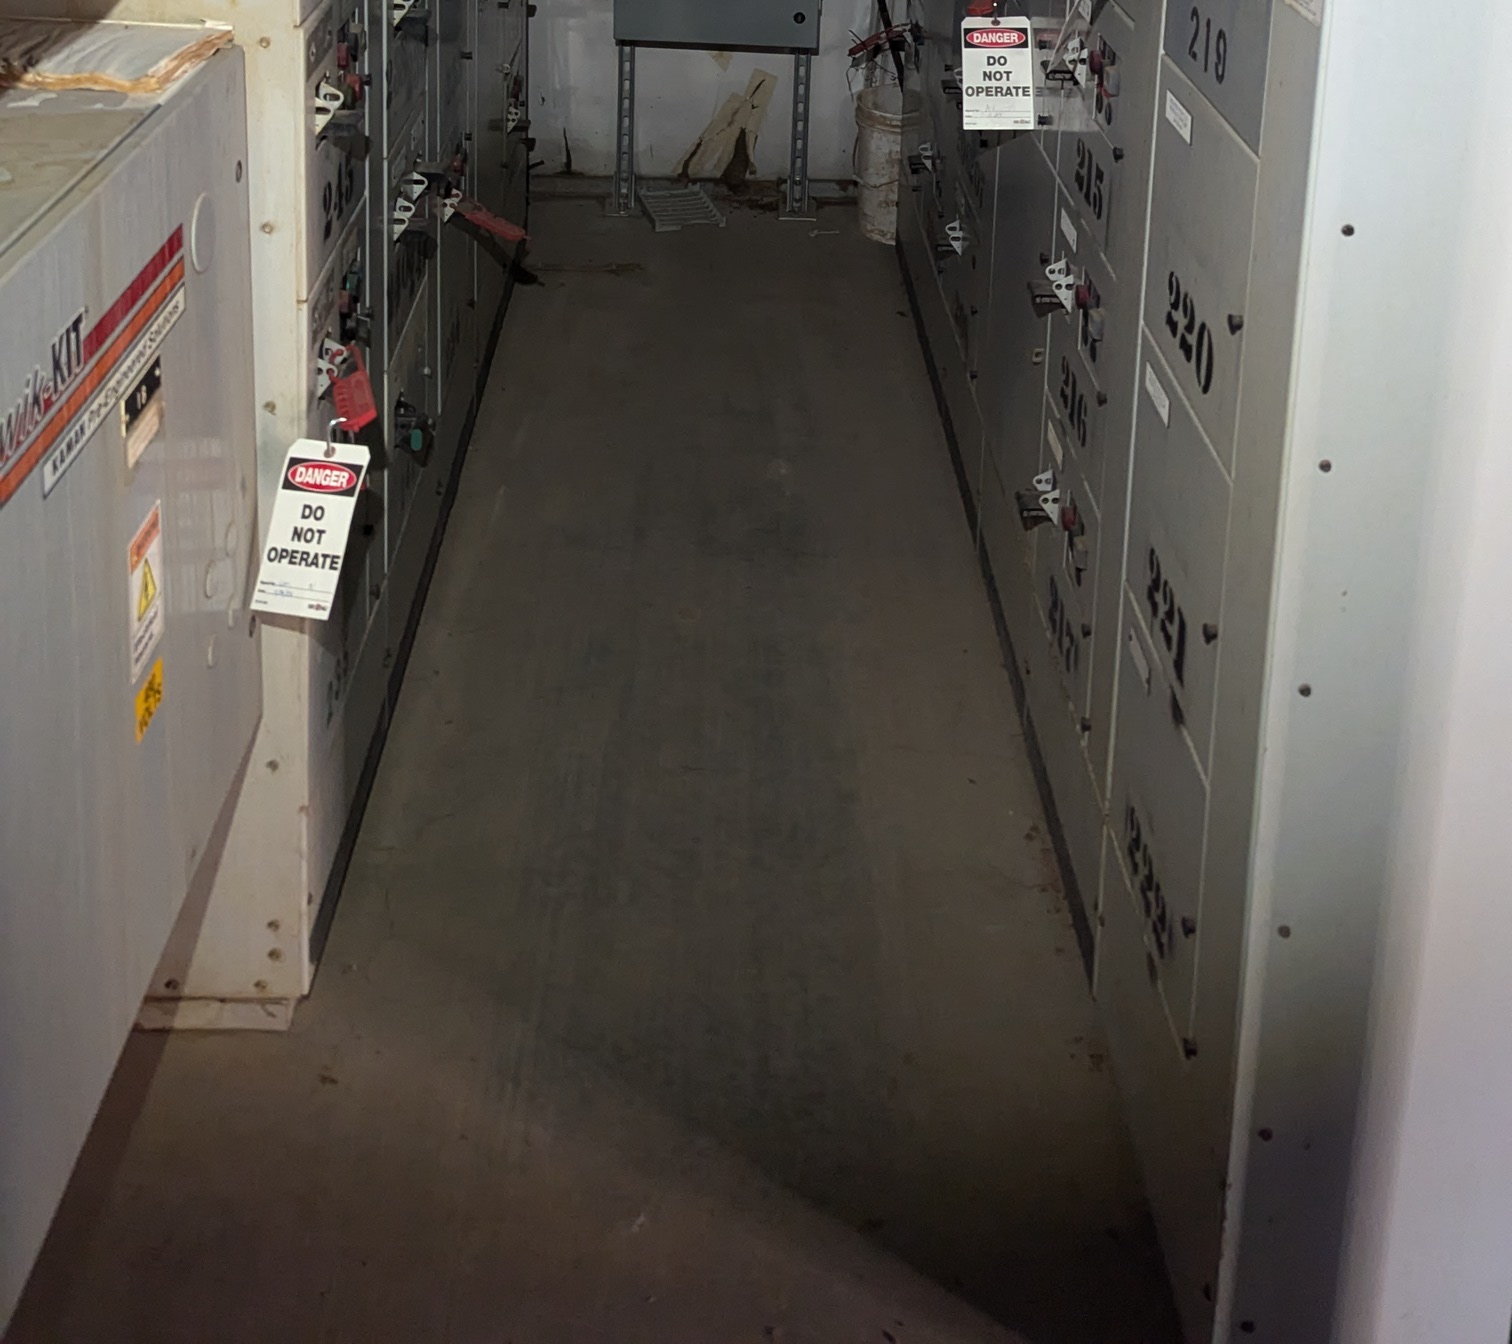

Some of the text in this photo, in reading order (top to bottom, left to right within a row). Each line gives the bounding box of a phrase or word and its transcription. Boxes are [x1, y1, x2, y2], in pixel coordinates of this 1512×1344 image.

[973, 32, 1018, 43] DANGER
[1188, 6, 1227, 84] 219
[986, 56, 1007, 67] DO
[982, 70, 1012, 82] NOT
[965, 86, 1031, 97] OPERATE
[1075, 138, 1104, 221] 215
[1165, 271, 1214, 395] 220
[294, 466, 350, 488] DANGER
[301, 504, 325, 521] DO
[291, 526, 326, 545] NOT
[267, 546, 341, 571] OPERATE
